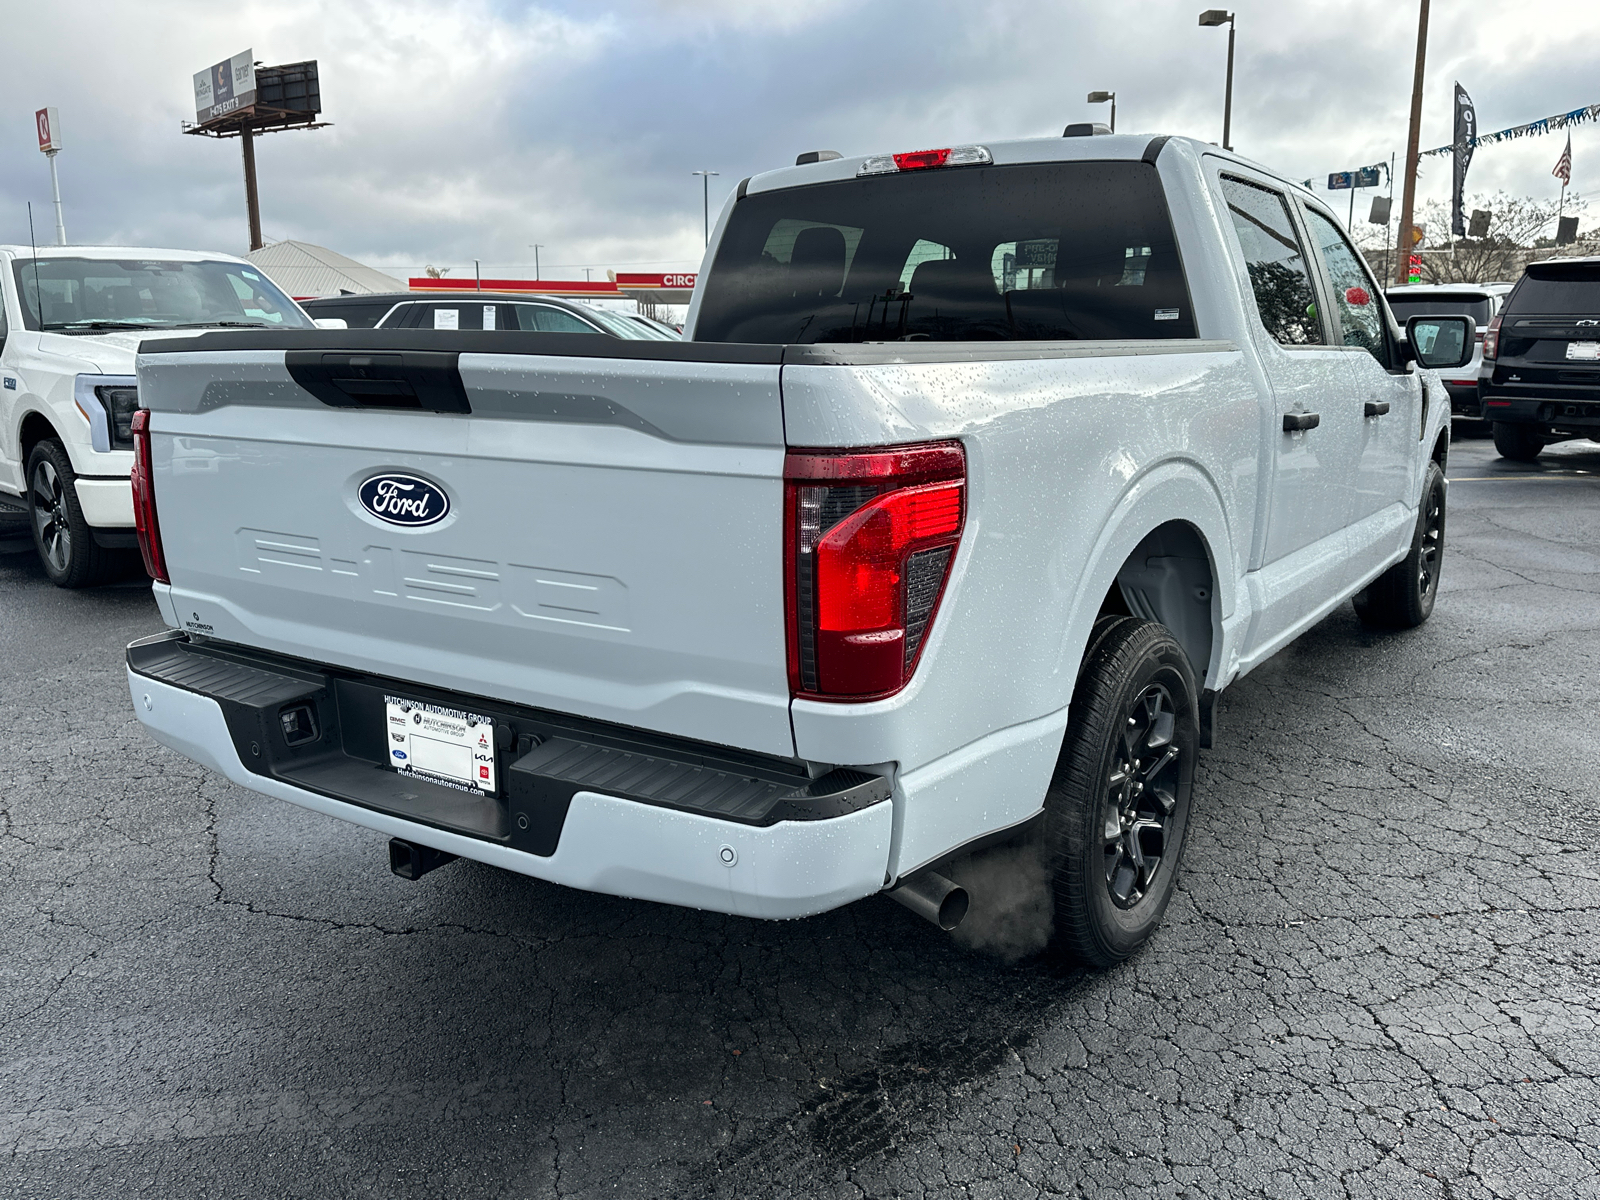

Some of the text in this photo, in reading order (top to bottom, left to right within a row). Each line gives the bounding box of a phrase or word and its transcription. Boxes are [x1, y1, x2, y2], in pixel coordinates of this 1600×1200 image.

[222, 98, 235, 111] EXIT
[235, 97, 239, 107] 9
[373, 480, 430, 517] Ford
[234, 527, 631, 632] F-150
[384, 695, 492, 725] HUTCHINSON AUTOMOTIVE GROUP
[423, 725, 449, 735] AUTOMOTIVE
